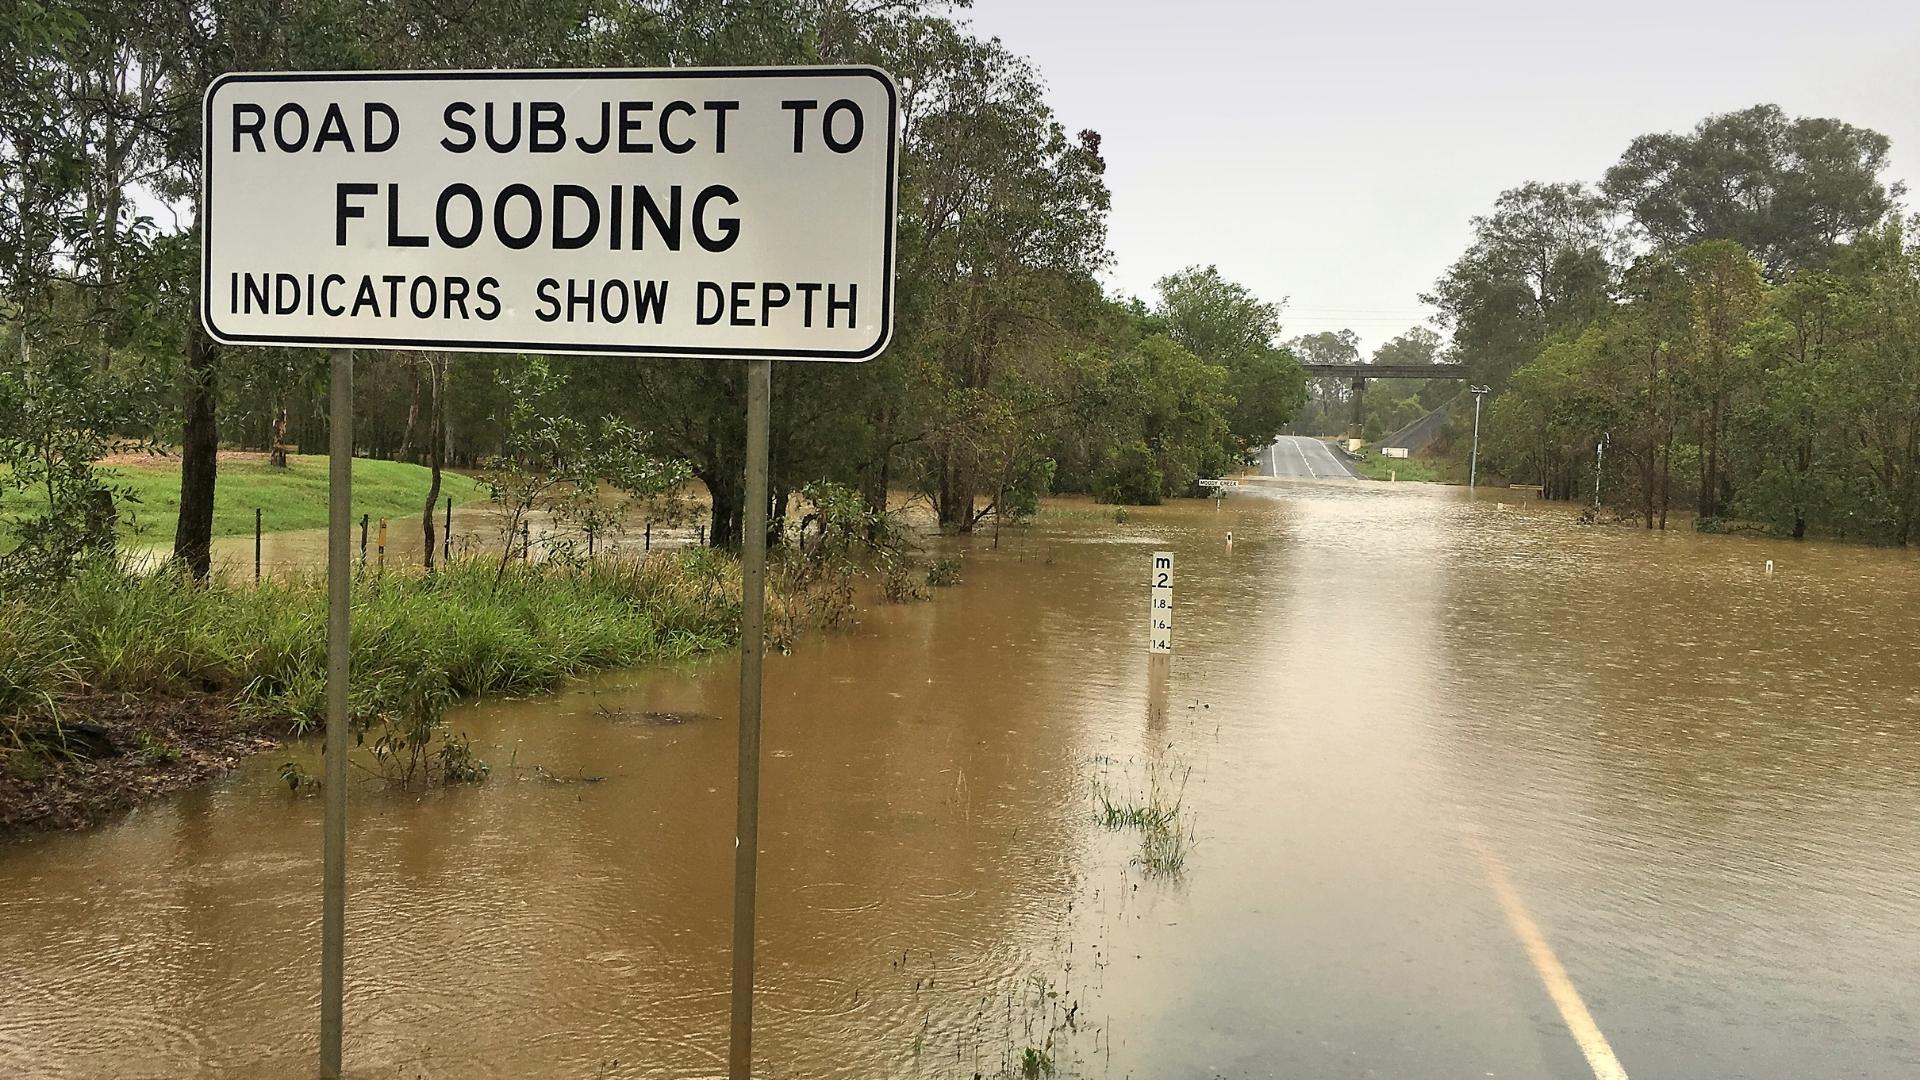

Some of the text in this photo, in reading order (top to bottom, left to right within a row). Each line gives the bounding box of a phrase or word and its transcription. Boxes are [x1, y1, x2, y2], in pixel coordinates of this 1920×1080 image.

[232, 98, 864, 155] ROAD SUBJECT TO
[335, 182, 741, 253] FLOODING
[231, 272, 858, 329] INDICATORS SHOW DEPTH
[1156, 557, 1170, 569] m
[1157, 573, 1168, 588] 2
[1153, 599, 1166, 609] 1.8
[1153, 620, 1166, 629] 1.6
[1152, 640, 1165, 649] 1.4
